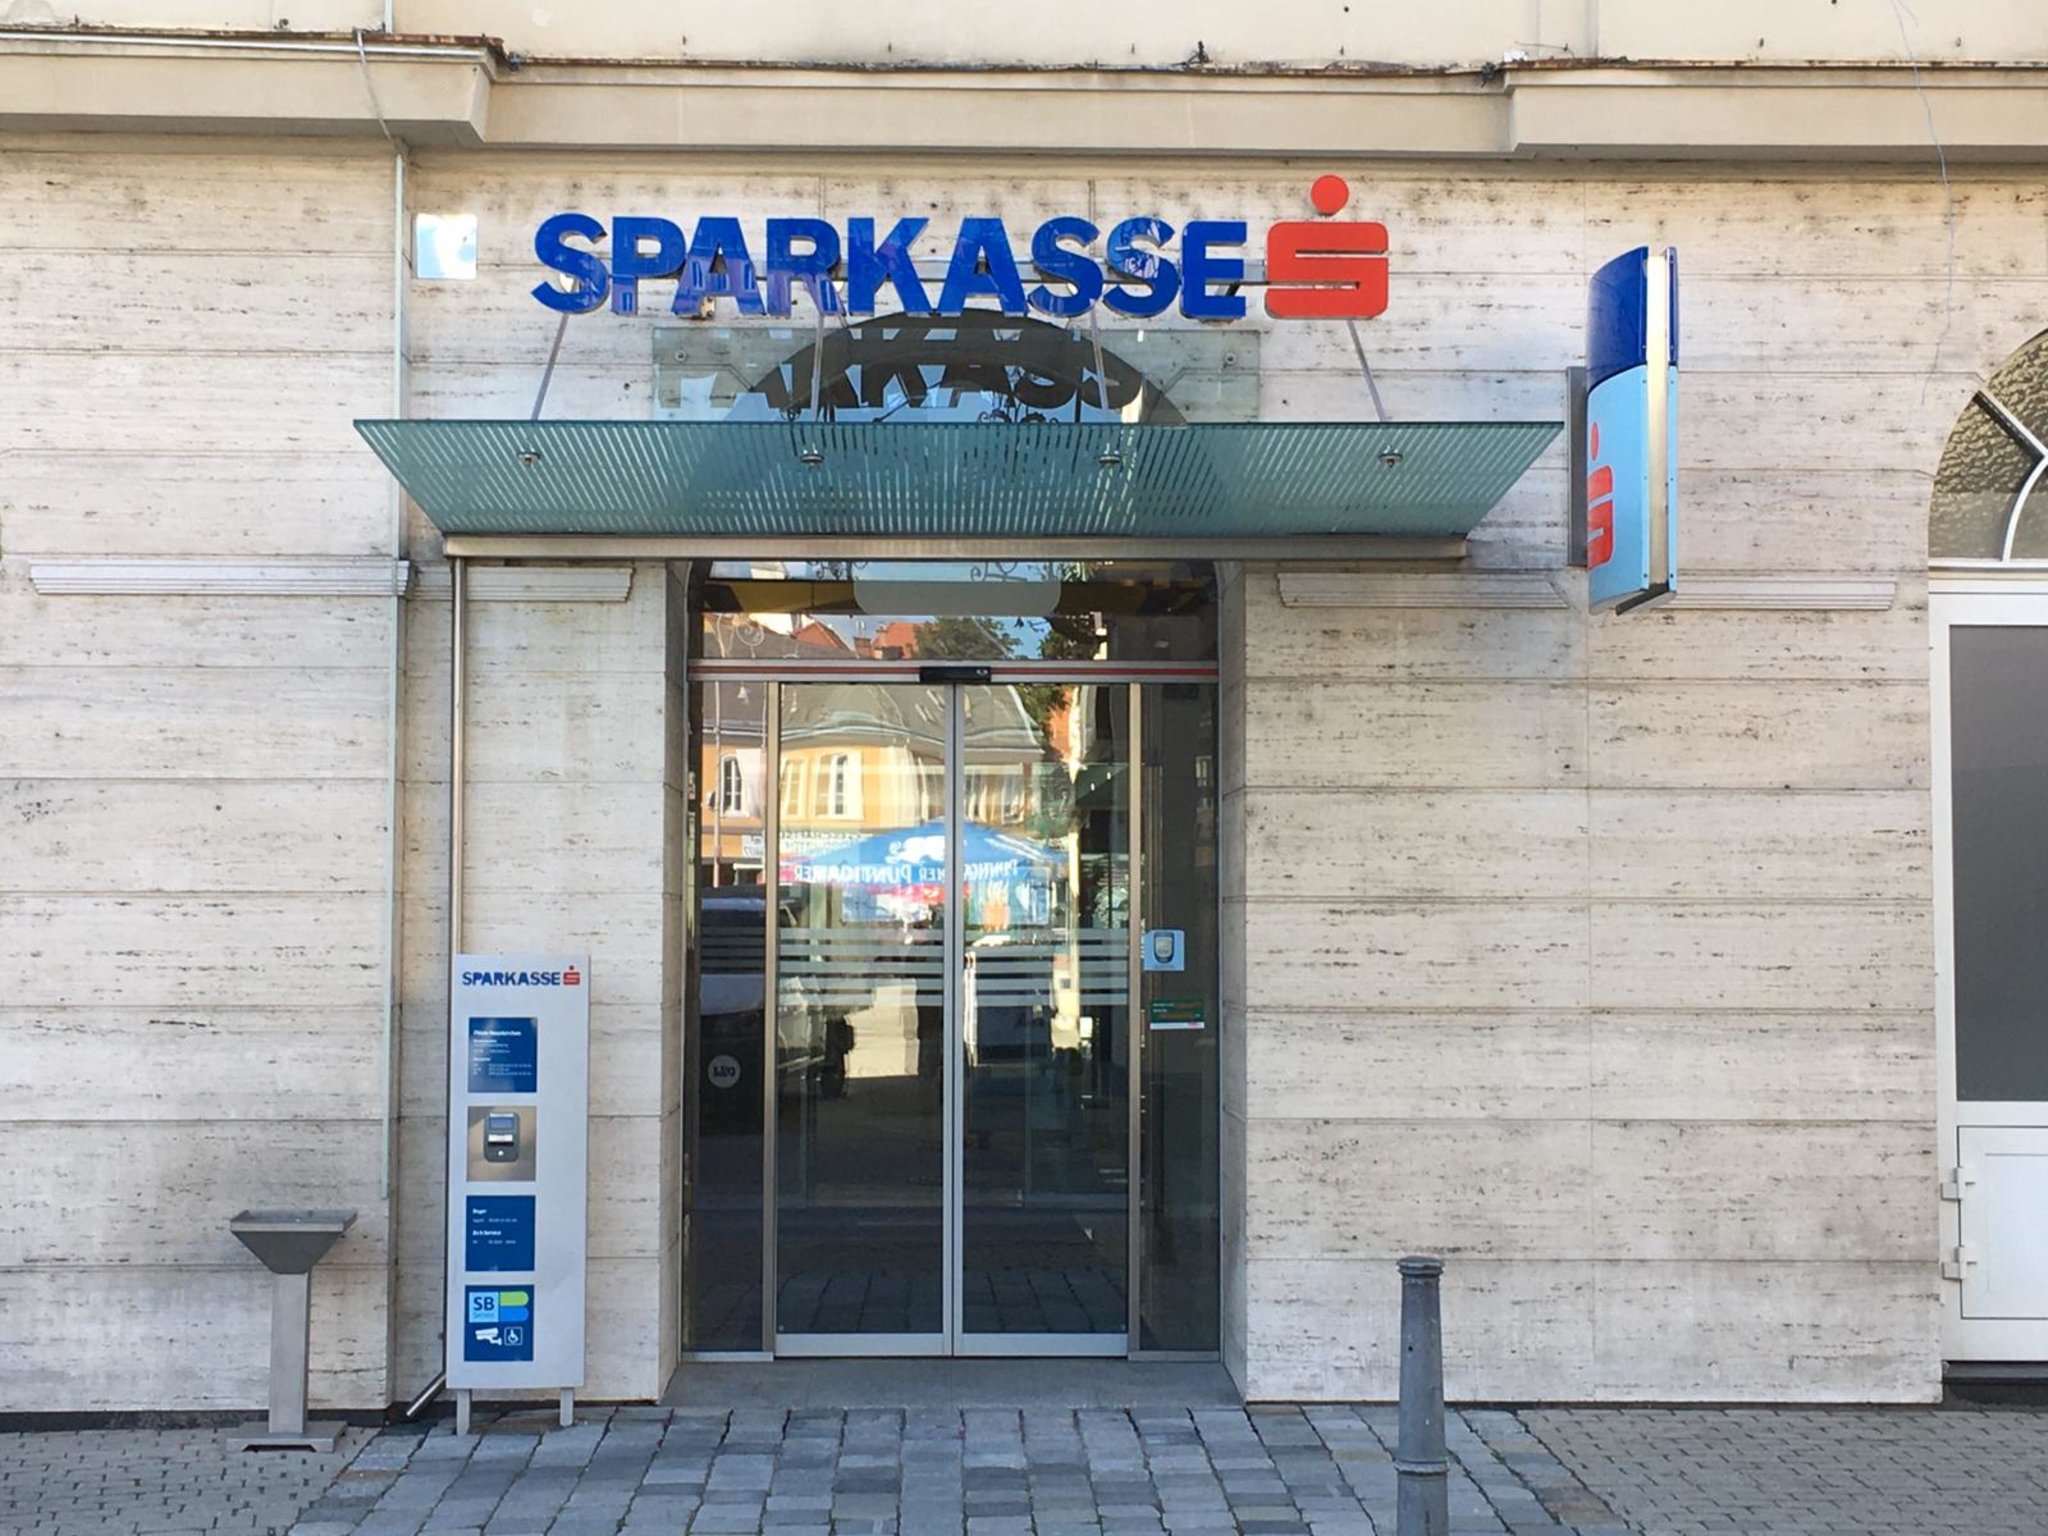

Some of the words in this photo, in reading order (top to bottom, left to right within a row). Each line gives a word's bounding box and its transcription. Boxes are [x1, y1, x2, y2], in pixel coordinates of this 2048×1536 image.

[530, 212, 1248, 320] SPARKASSE
[462, 971, 560, 986] SPARKASSE
[473, 1296, 495, 1311] SB
